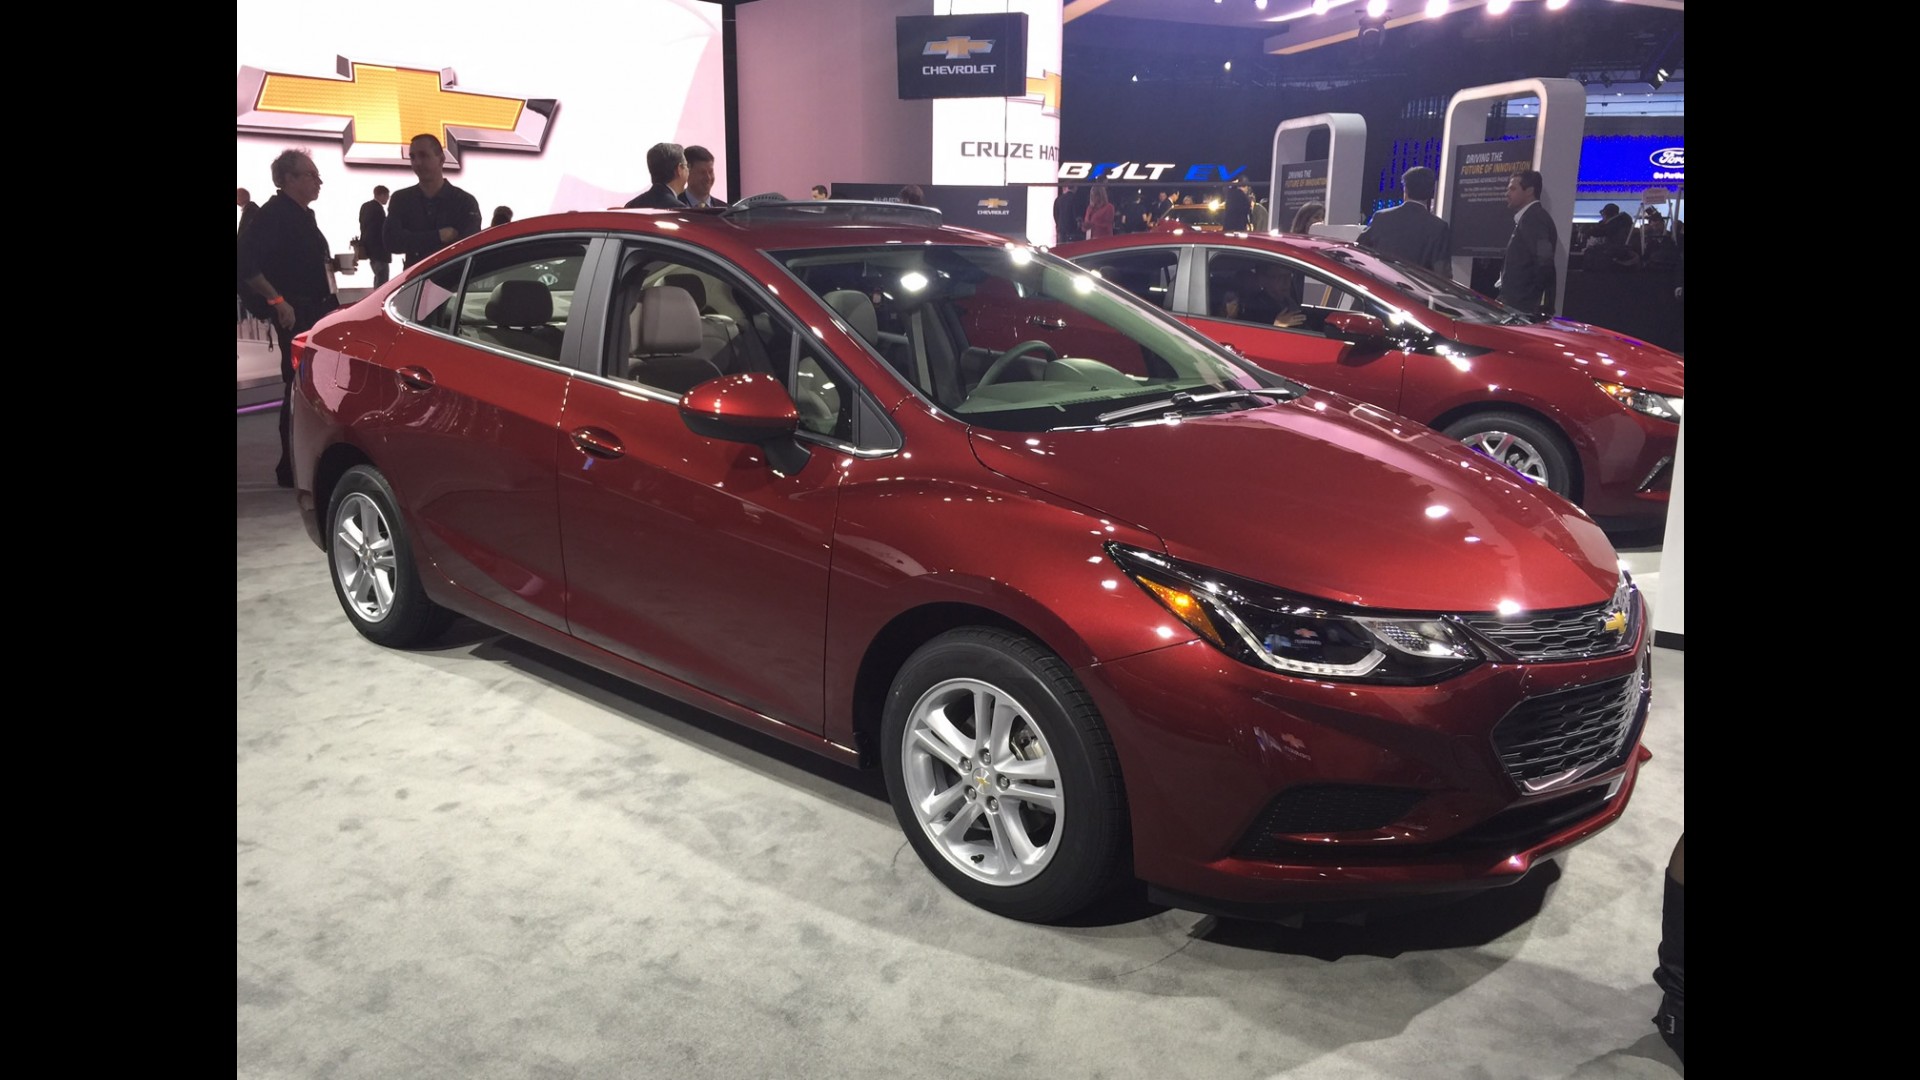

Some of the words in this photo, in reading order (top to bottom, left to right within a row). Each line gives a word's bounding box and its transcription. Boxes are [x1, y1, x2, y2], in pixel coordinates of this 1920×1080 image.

[922, 64, 996, 76] CHEVROLET
[960, 141, 1034, 159] CRUZE
[1466, 153, 1490, 164] DRIVING
[1491, 152, 1504, 162] THE
[1183, 163, 1248, 181] EV
[1461, 165, 1484, 176] FUTURE
[1484, 164, 1493, 174] OF
[1493, 160, 1531, 174] INNOVATION
